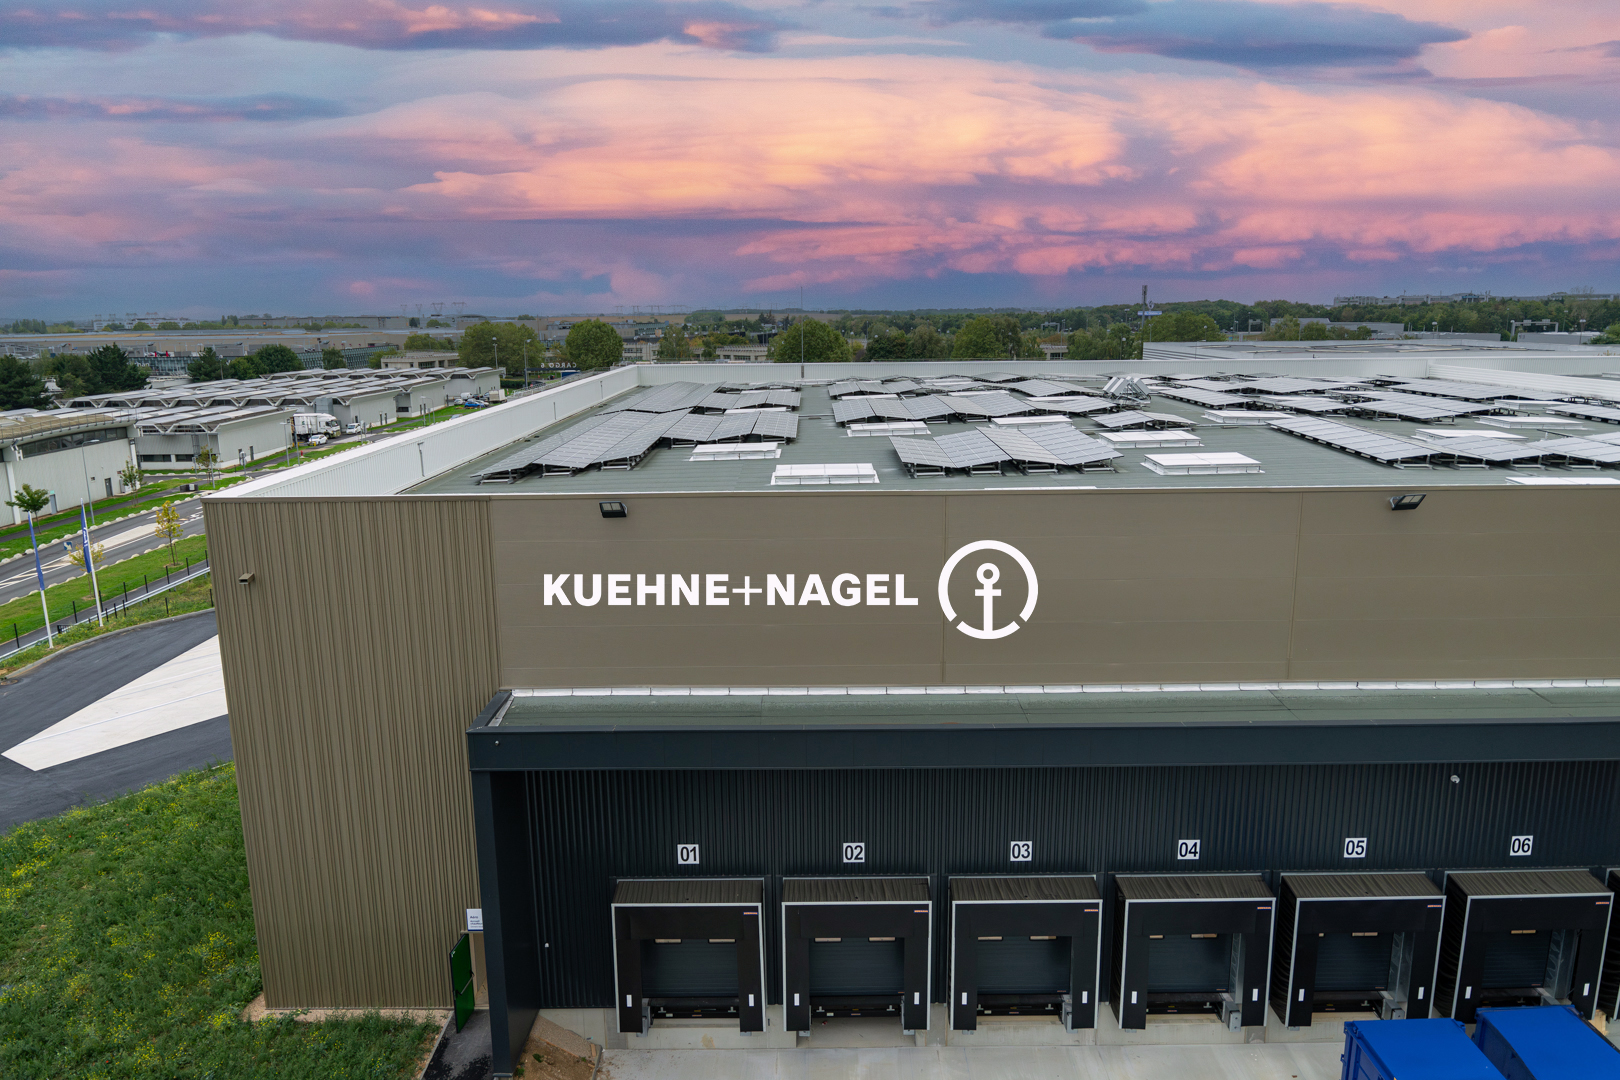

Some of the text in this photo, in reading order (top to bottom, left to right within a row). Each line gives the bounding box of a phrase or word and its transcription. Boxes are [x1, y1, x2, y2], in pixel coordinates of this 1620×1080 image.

[543, 573, 919, 607] KUEHNE+NAGEL
[1011, 843, 1031, 859] 03
[1178, 842, 1199, 858] 04
[1345, 840, 1365, 856] 05
[1511, 836, 1531, 853] 06
[680, 846, 697, 862] 01
[844, 845, 863, 861] 02
